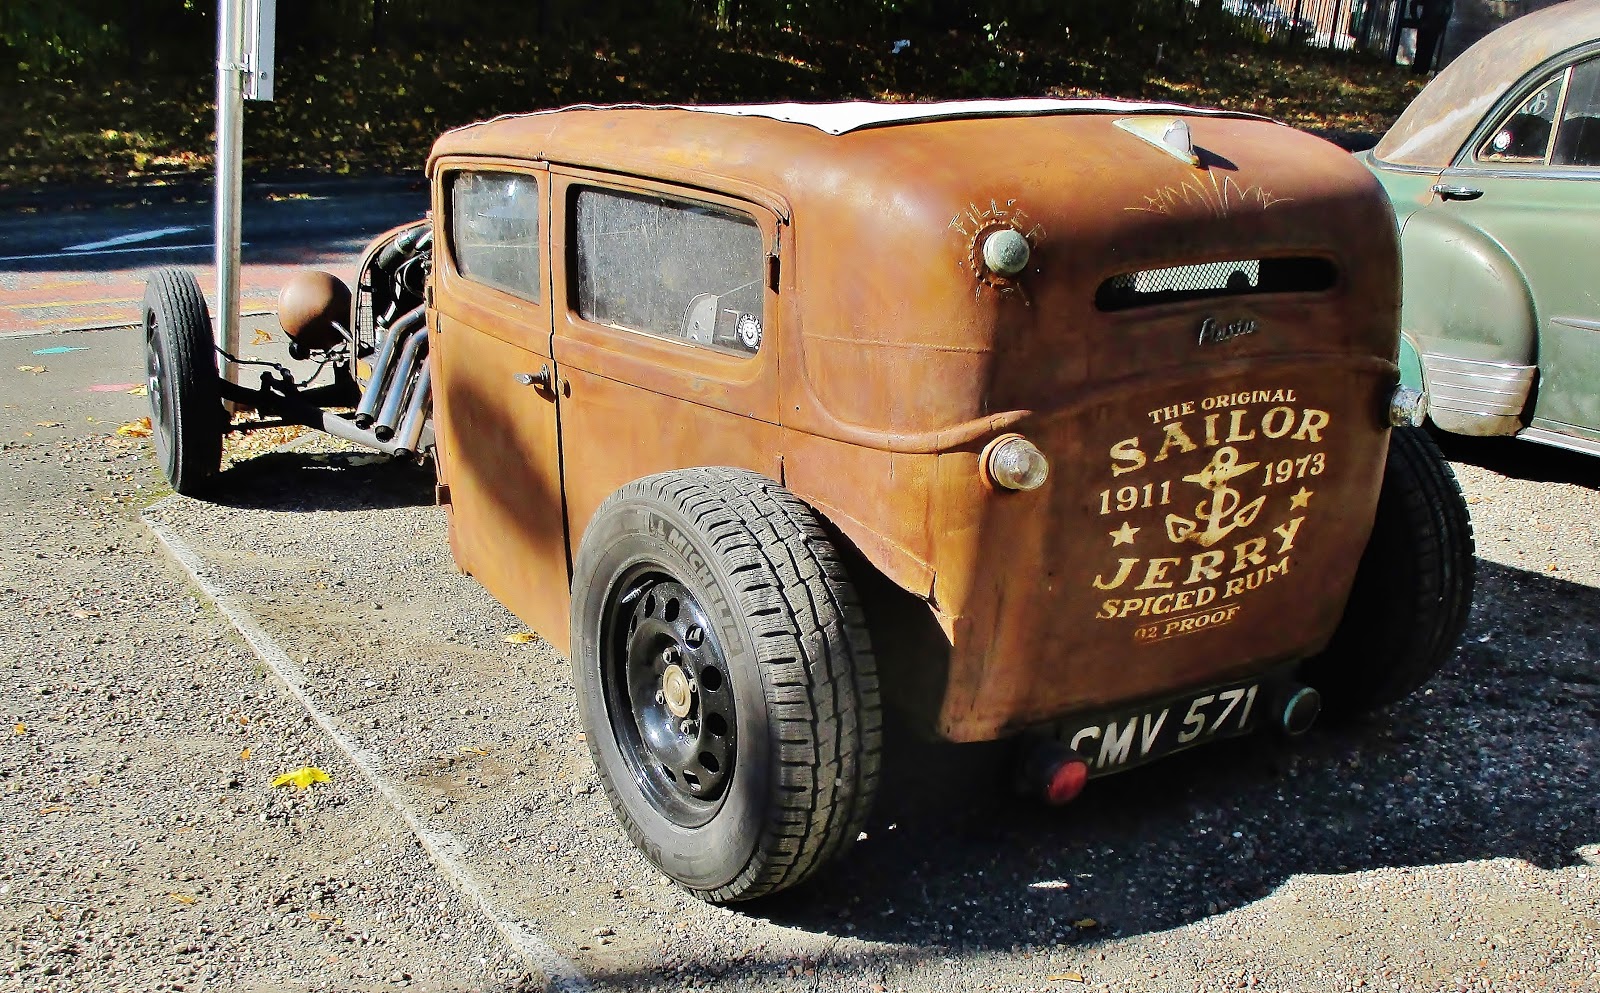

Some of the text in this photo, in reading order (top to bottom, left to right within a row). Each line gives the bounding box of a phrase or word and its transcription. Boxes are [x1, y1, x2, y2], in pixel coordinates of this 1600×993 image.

[1148, 389, 1296, 424] THE ORIGINAL
[1109, 406, 1330, 477] SAILOR
[1262, 452, 1326, 487] 1973
[1100, 480, 1171, 515] 1911
[1092, 516, 1305, 590] JERRY
[1096, 556, 1289, 619] SPICED RUM
[1163, 606, 1240, 635] PROOF
[1070, 684, 1259, 768] CMV 571
